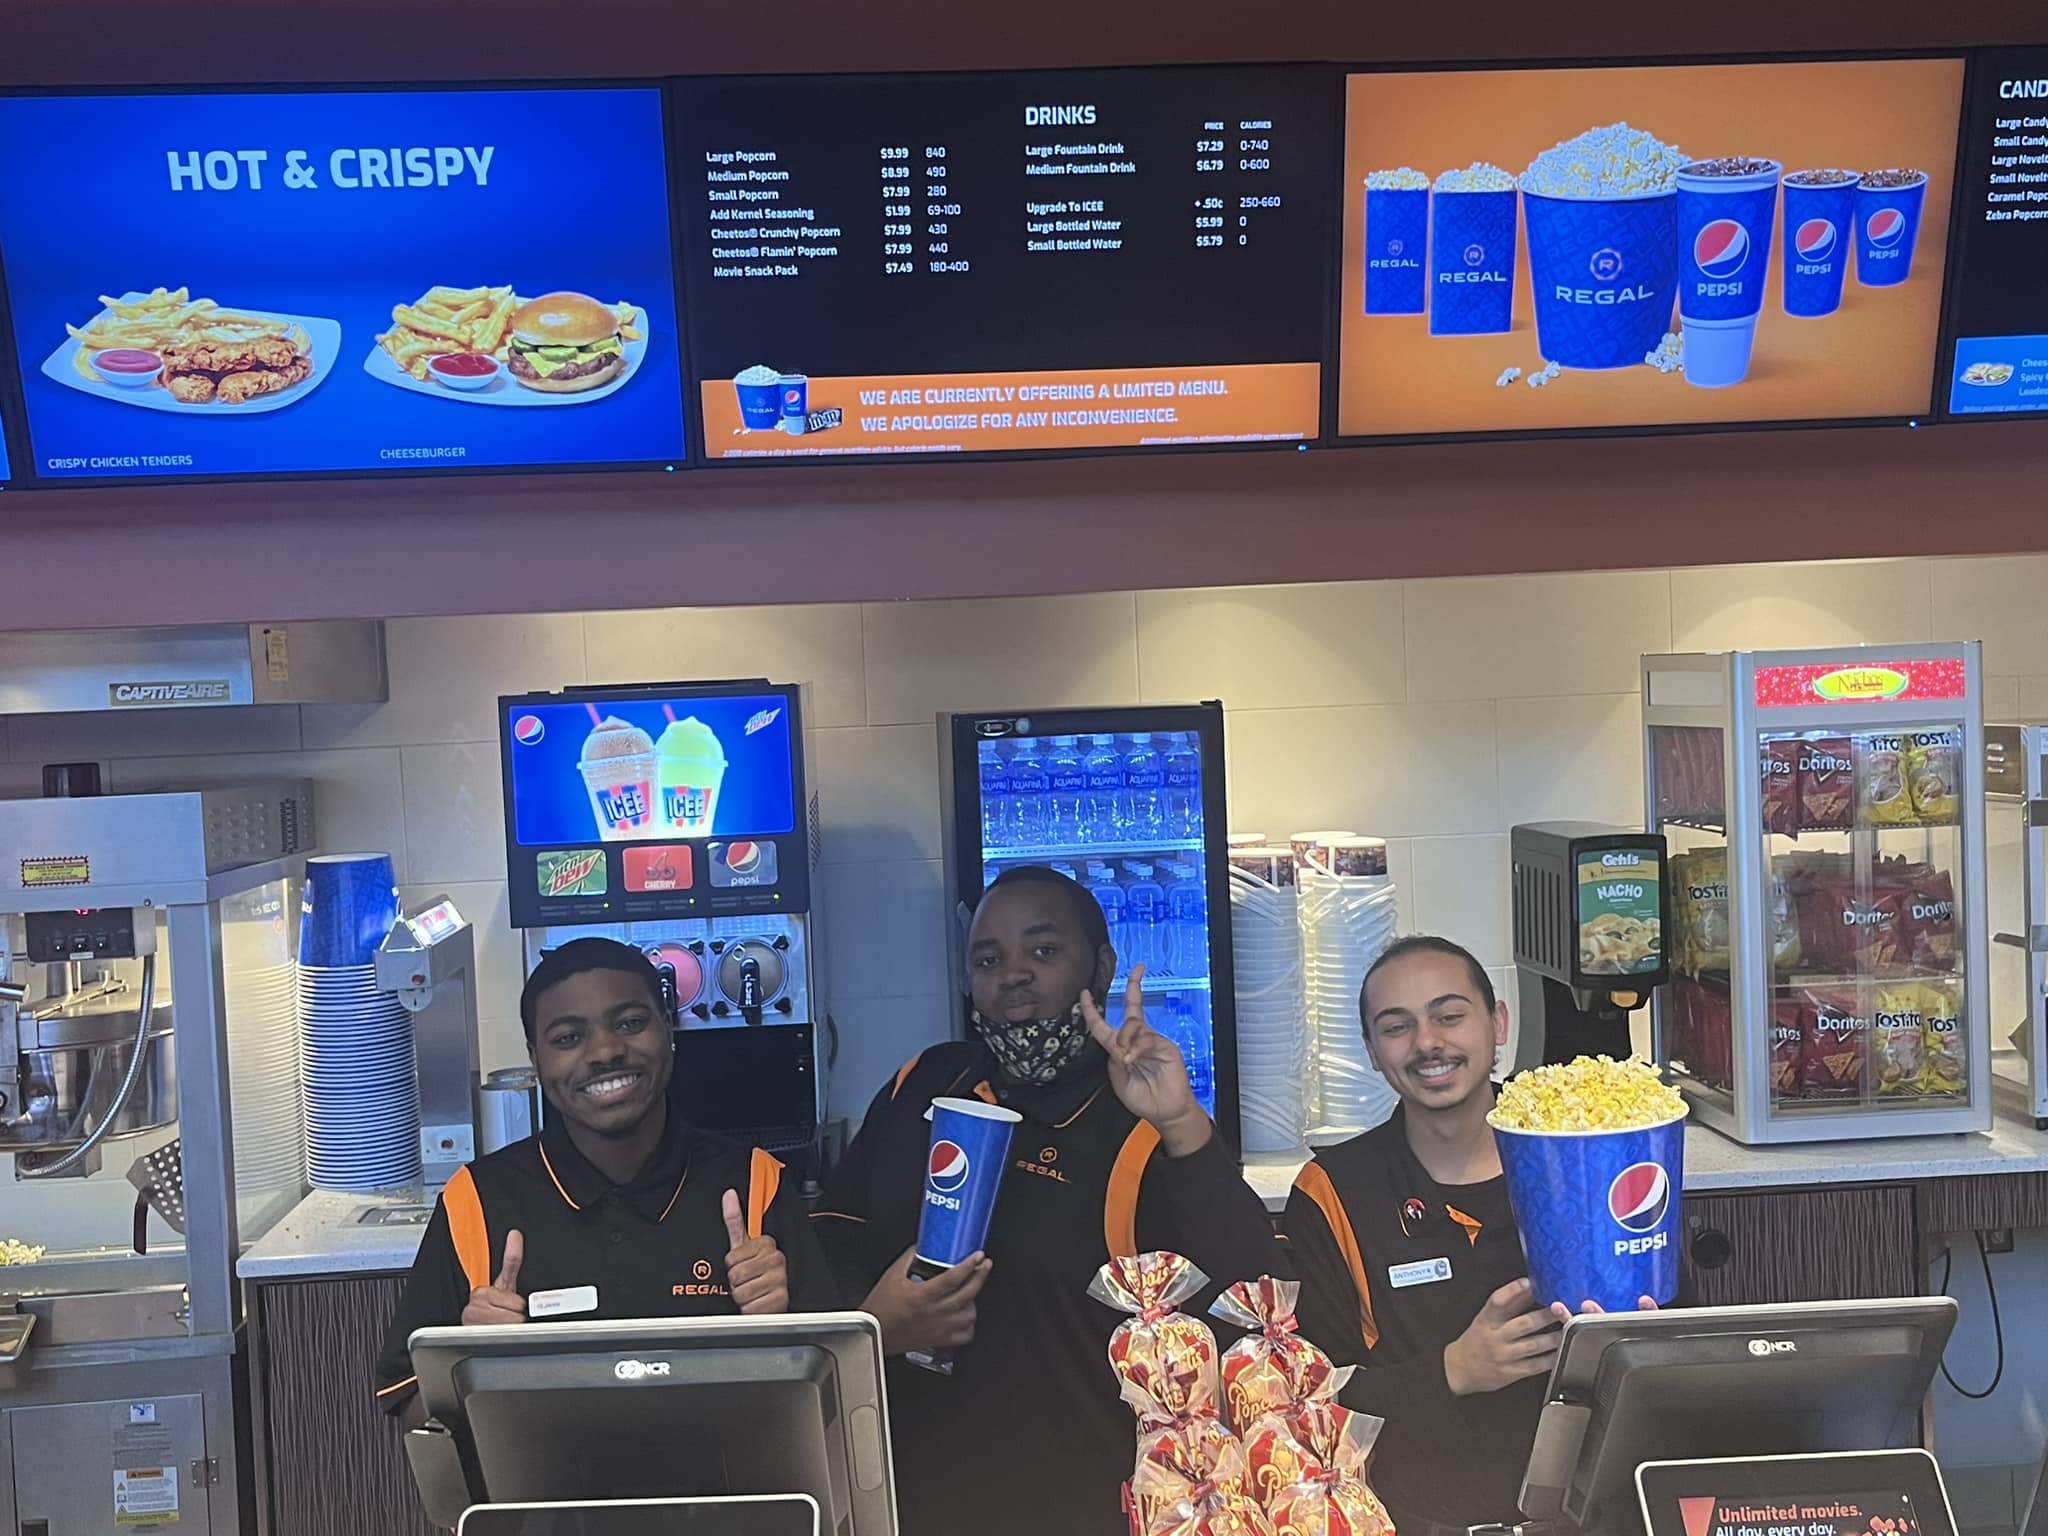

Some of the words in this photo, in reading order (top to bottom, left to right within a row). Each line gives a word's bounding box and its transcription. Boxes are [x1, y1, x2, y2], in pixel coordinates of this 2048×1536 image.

[2000, 79, 2048, 98] CAND
[1025, 106, 1096, 125] DRINKS
[1204, 122, 1224, 130] PRICE
[1240, 120, 1272, 129] CALORIES
[1995, 117, 2022, 130] Large
[1197, 140, 1223, 152] $7.29
[1240, 140, 1268, 150] 0-740
[1993, 135, 2020, 147] Small
[880, 148, 909, 159] $9.99
[926, 147, 945, 158] 840
[1026, 144, 1052, 158] Large
[1054, 143, 1096, 155] Fountain
[1098, 142, 1124, 154] Drink
[706, 152, 734, 164] Large
[736, 151, 776, 164] Popcorn
[1991, 155, 2018, 168] Large
[167, 149, 267, 191] HOT
[283, 150, 317, 189] &
[330, 146, 494, 188] CRISPY
[1026, 164, 1064, 174] Medium
[1066, 162, 1108, 174] Fountain
[1110, 162, 1136, 173] Drink
[1196, 160, 1223, 171] $6.79
[1240, 159, 1269, 170] 0-600
[708, 171, 747, 181] Medium
[749, 170, 788, 183] Popcorn
[881, 167, 909, 179] $8.99
[926, 166, 946, 177] 490
[1990, 172, 2017, 184] Small
[709, 190, 737, 201] Small
[739, 190, 778, 202] Popcorn
[882, 186, 910, 198] $7.99
[927, 186, 946, 196] 280
[1987, 190, 2025, 202] Caramel
[1026, 202, 1066, 214] Upgrade
[1068, 202, 1081, 212] To
[1083, 201, 1103, 211] ICEE
[1240, 197, 1280, 208] 250-660
[710, 210, 729, 220] Add
[731, 209, 763, 220] Kernel
[765, 208, 814, 220] Seasoning
[885, 205, 910, 216] $1.99
[928, 204, 960, 216] 69-100
[1985, 209, 2012, 221] Zebra
[1027, 221, 1054, 234] Large
[1056, 220, 1090, 232] Bottled
[1092, 220, 1121, 230] Water
[1196, 217, 1223, 228] $5.99
[1240, 216, 1246, 227] 0
[711, 228, 758, 240] Cheetos®
[760, 228, 798, 240] Crunchy
[801, 227, 840, 238] Popcorn
[884, 224, 912, 236] $7.99
[928, 224, 947, 234] 430
[1028, 240, 1055, 251] Small
[1057, 240, 1090, 250] Bottled
[1092, 239, 1122, 250] Water
[1196, 236, 1223, 247] $5.79
[1240, 235, 1246, 246] 0
[712, 247, 758, 258] Cheetos®
[761, 246, 796, 258] Flamin'
[798, 246, 837, 258] Popcorn
[885, 244, 912, 255] $7.99
[929, 243, 948, 253] 440
[1869, 249, 1899, 259] PEPSI
[886, 262, 913, 274] $7.49
[930, 262, 969, 272] 180-400
[1370, 259, 1419, 269] REGAL
[1796, 263, 1831, 275] PEPSI
[714, 266, 742, 278] Movie
[745, 266, 773, 276] Snack
[775, 264, 798, 276] Pack
[1440, 271, 1507, 284] REGAL
[1555, 285, 1655, 305] REGAL
[1697, 282, 1743, 297] PEPSI
[860, 391, 886, 406] WE
[890, 390, 920, 404] ARE
[925, 388, 1014, 404] CURRENTLY
[1019, 384, 1094, 400] OFFERING
[1098, 384, 1110, 398] A
[1114, 382, 1174, 398] LIMITED
[1179, 380, 1228, 396] MENU.
[861, 417, 887, 432] WE
[891, 414, 978, 430] APOLOGIZE
[982, 414, 1012, 428] FOR
[1016, 412, 1048, 426] ANY
[1052, 408, 1178, 426] INCONVENIENCE.
[379, 446, 467, 460] CHEESEBURGER
[48, 457, 87, 469] CRISPY
[90, 456, 139, 468] CHICKEN
[141, 455, 193, 466] TENDERS
[1799, 756, 1852, 771] Doritos
[603, 791, 646, 821] ICEE
[667, 795, 703, 818] ICEE
[644, 880, 676, 890] CHERRY
[730, 876, 760, 887] pepsi
[1597, 883, 1643, 899] NACHO
[1818, 1016, 1871, 1031] Doritos
[1016, 1160, 1072, 1184] REGAL
[925, 1190, 960, 1210] PEPSI
[1614, 1231, 1667, 1256] PEPSI
[672, 1284, 728, 1296] REGAL
[1770, 1340, 1797, 1352] NCR
[641, 1361, 671, 1375] NCR
[1718, 1504, 1798, 1523] Unlimited
[1801, 1502, 1863, 1519] movies.
[1715, 1526, 1734, 1536] All
[1808, 1521, 1837, 1536] day.
